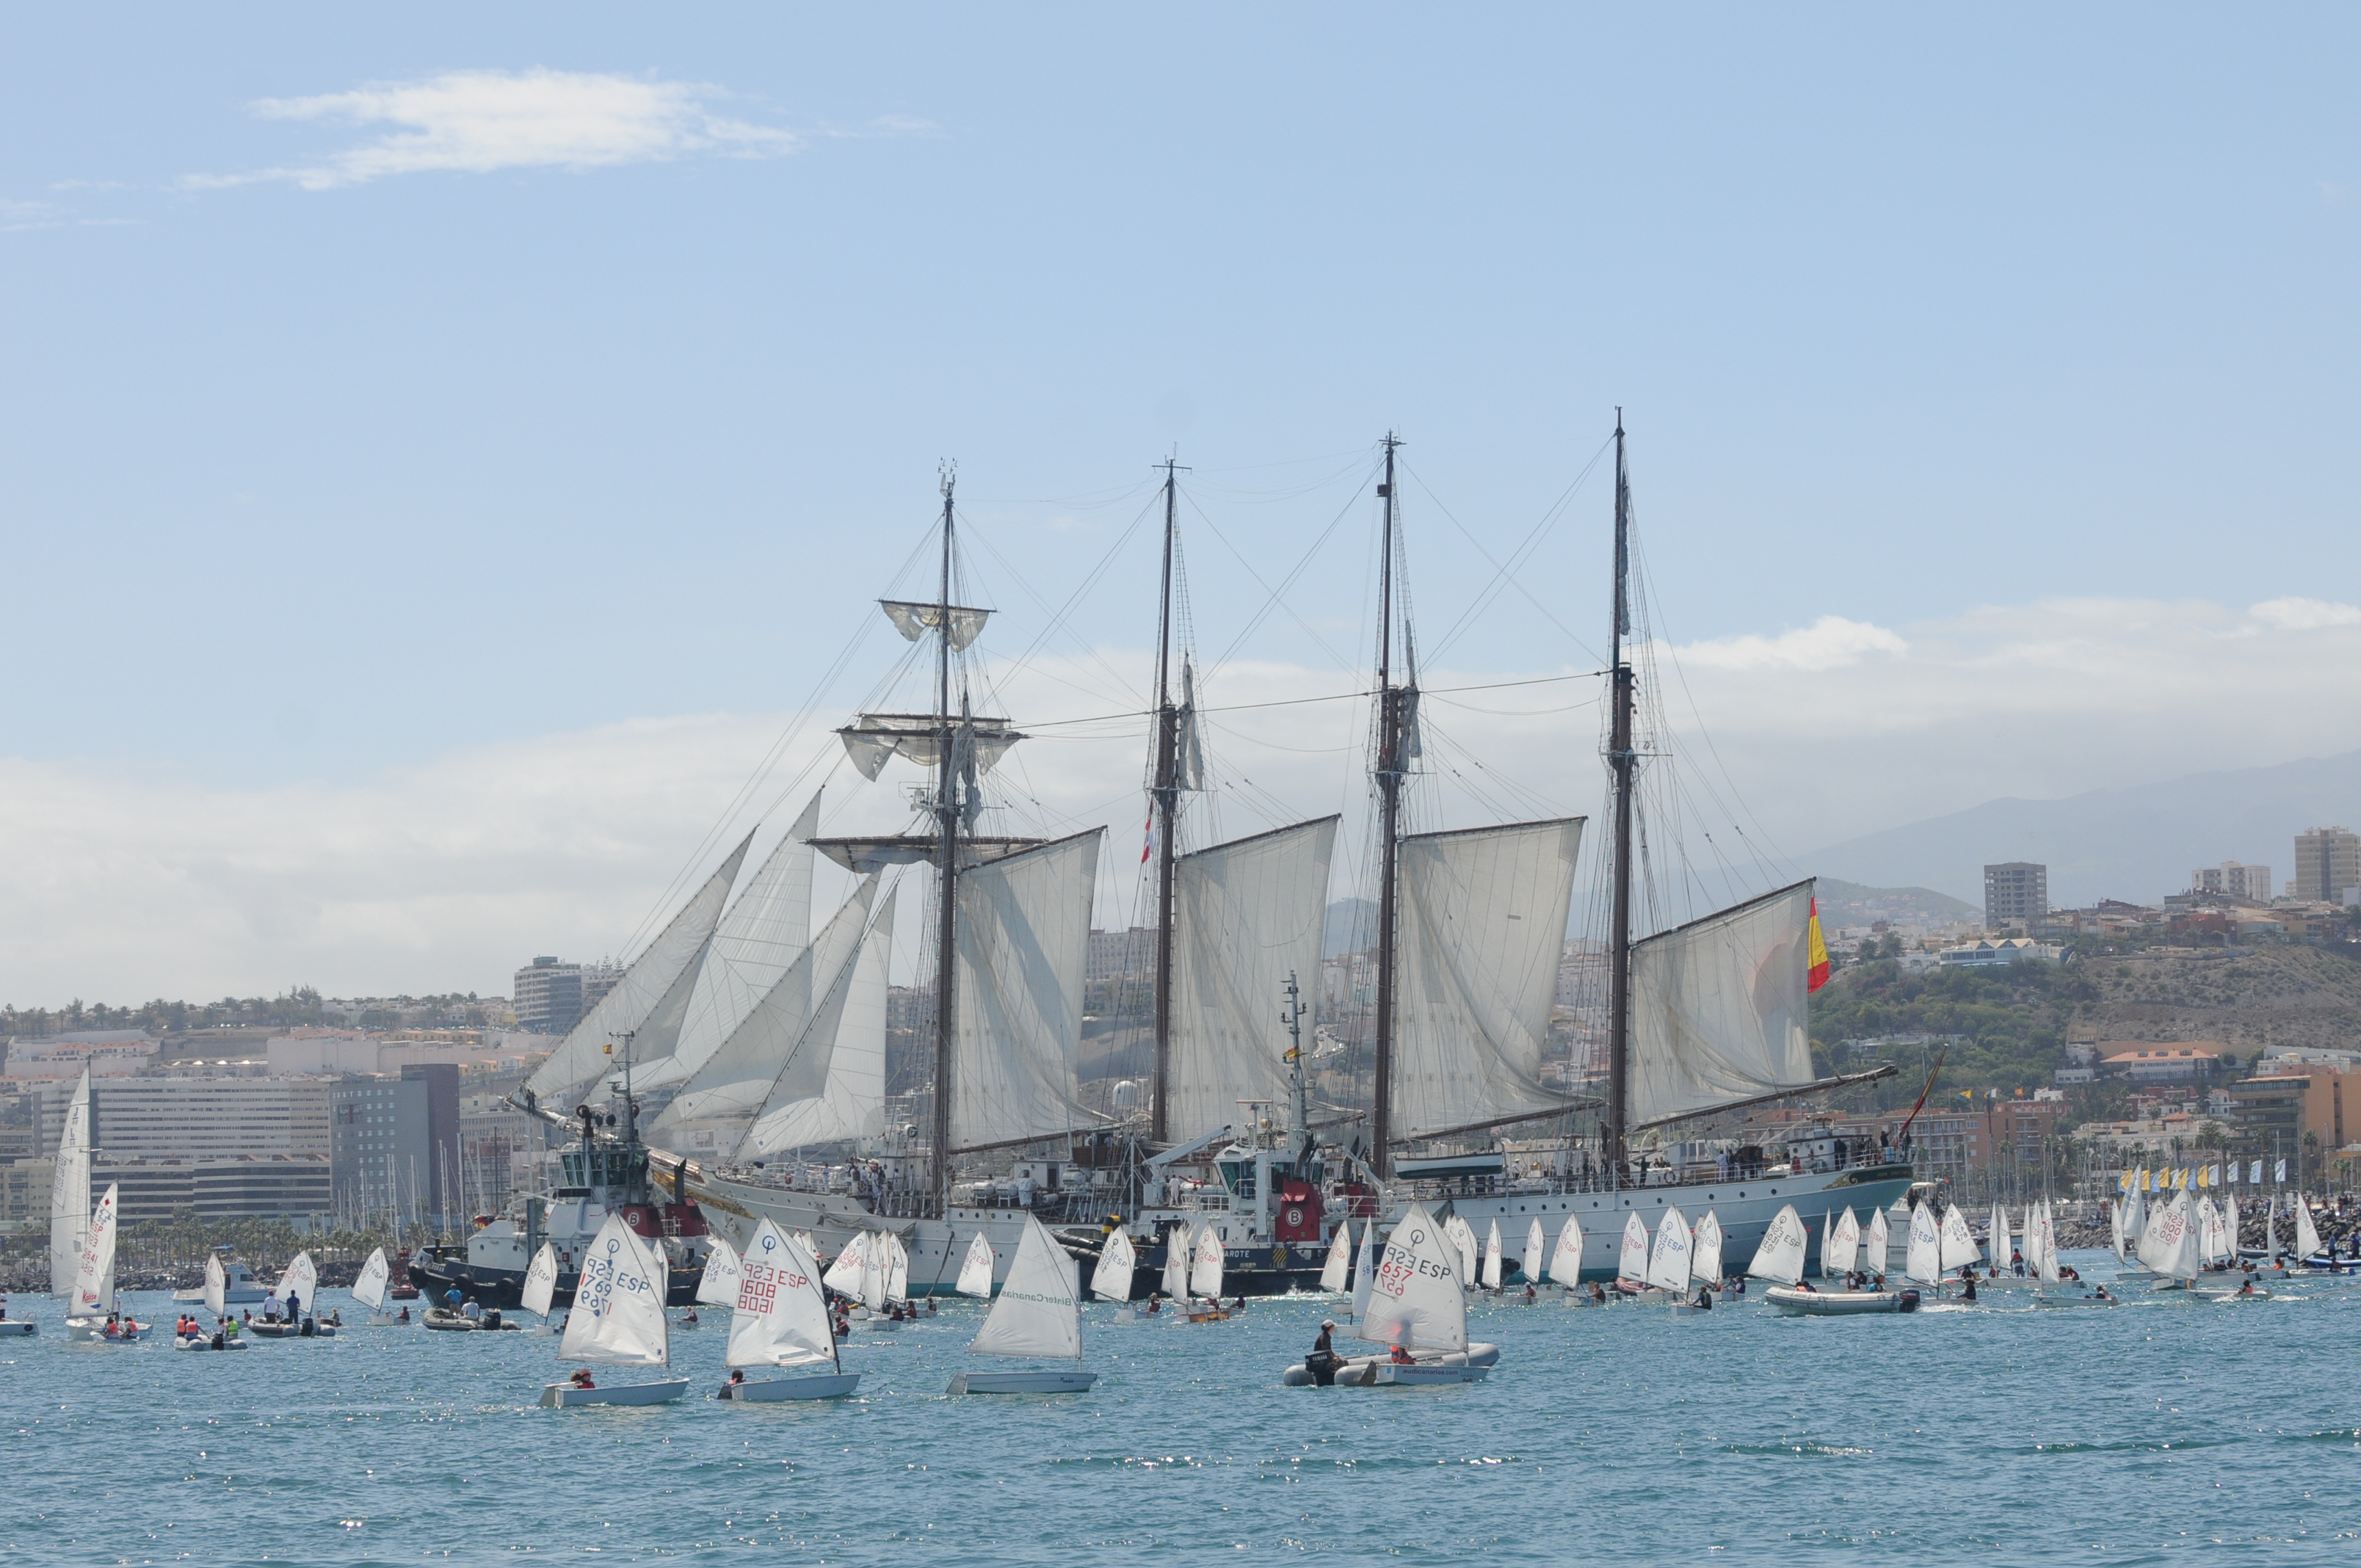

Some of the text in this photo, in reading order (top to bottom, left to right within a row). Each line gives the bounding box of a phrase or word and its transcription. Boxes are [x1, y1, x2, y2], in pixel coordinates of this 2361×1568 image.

[629, 1213, 638, 1225] B
[1291, 1211, 1299, 1223] B
[1783, 1235, 1801, 1248] ESP
[1918, 1231, 1934, 1244] ESP
[1564, 1241, 1577, 1253] ESP
[1631, 1240, 1642, 1250] ESP
[1667, 1238, 1685, 1252] ESP
[976, 1255, 990, 1266] ESP
[1112, 1255, 1128, 1267] ESP
[1204, 1251, 1217, 1263] ESP
[371, 1268, 384, 1280] ESP
[537, 1268, 551, 1282] ESP
[706, 1265, 719, 1277] 676
[721, 1265, 736, 1277] ESP
[1363, 1265, 1371, 1277] 58
[1382, 1261, 1413, 1282] 657
[1418, 1259, 1451, 1280] ESP
[297, 1271, 311, 1282] ESP
[777, 1270, 808, 1289] ESP
[580, 1272, 612, 1297] 1769
[616, 1272, 650, 1294] ESP
[740, 1279, 777, 1299] 1608
